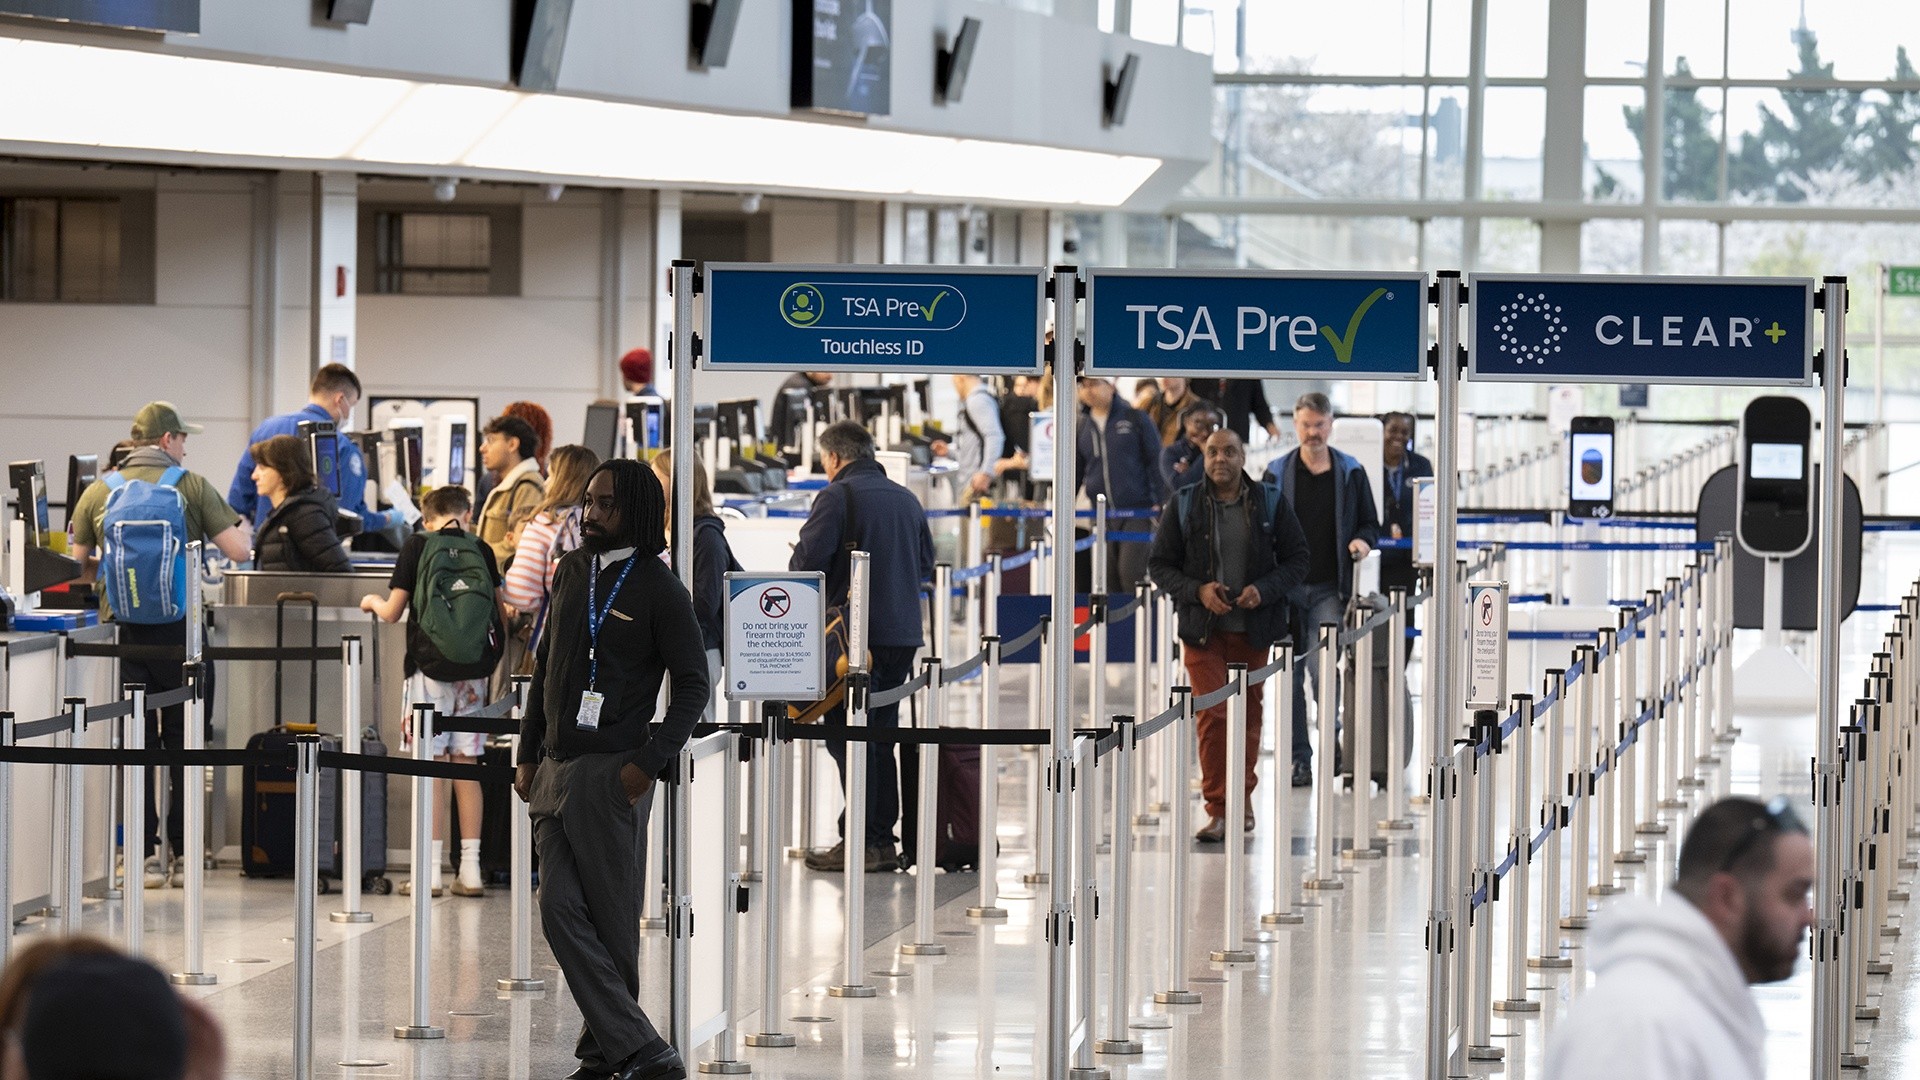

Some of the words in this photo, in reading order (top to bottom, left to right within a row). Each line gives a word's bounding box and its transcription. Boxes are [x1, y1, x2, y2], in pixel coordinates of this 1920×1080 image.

[842, 297, 881, 317] TSA
[886, 298, 919, 318] Pre
[1125, 304, 1222, 351] TSA
[1236, 306, 1317, 352] Pre
[821, 338, 902, 355] Touchless
[906, 339, 924, 356] ID
[742, 622, 754, 630] Do
[755, 622, 767, 630] not
[769, 622, 789, 631] bring
[790, 622, 808, 631] your
[746, 631, 774, 639] firearm
[775, 631, 805, 640] through
[747, 640, 760, 648] the
[761, 640, 803, 648] checkpoint.
